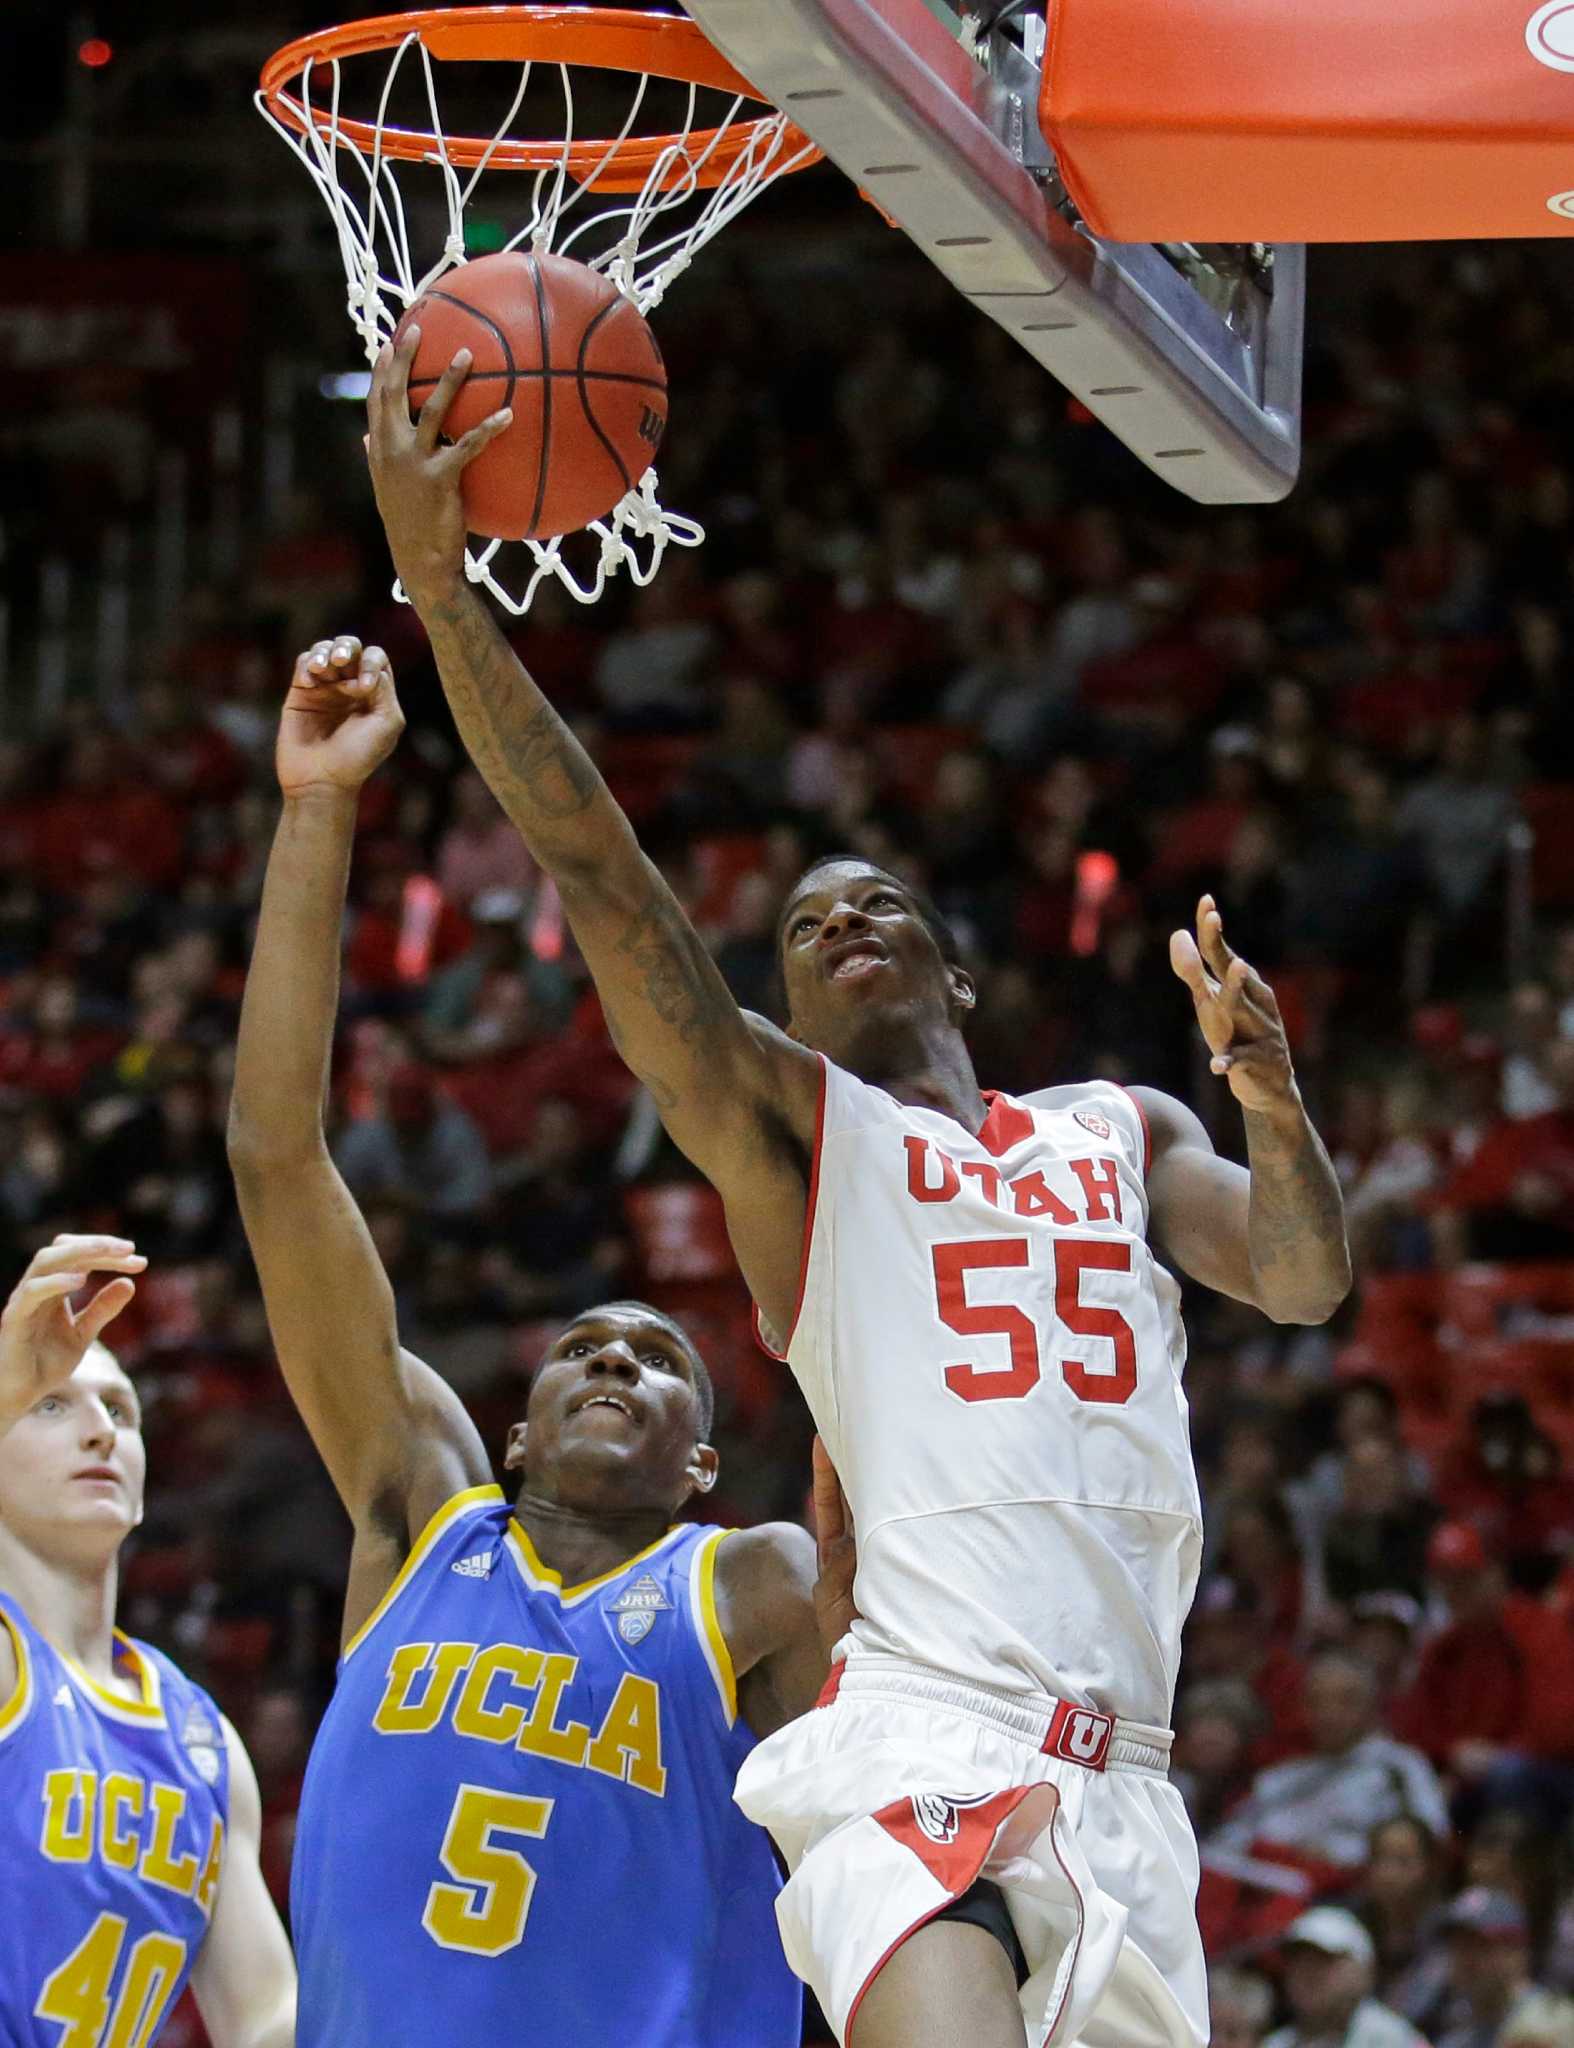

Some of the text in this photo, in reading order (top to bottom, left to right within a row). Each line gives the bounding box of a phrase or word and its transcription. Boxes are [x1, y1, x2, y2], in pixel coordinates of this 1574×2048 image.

[903, 1134, 1123, 1227] UTAH
[929, 1233, 1139, 1408] 55
[372, 1642, 667, 1798] UCLA
[1069, 1713, 1108, 1759] U
[421, 1783, 555, 1957] 5
[34, 1910, 187, 2048] 40
